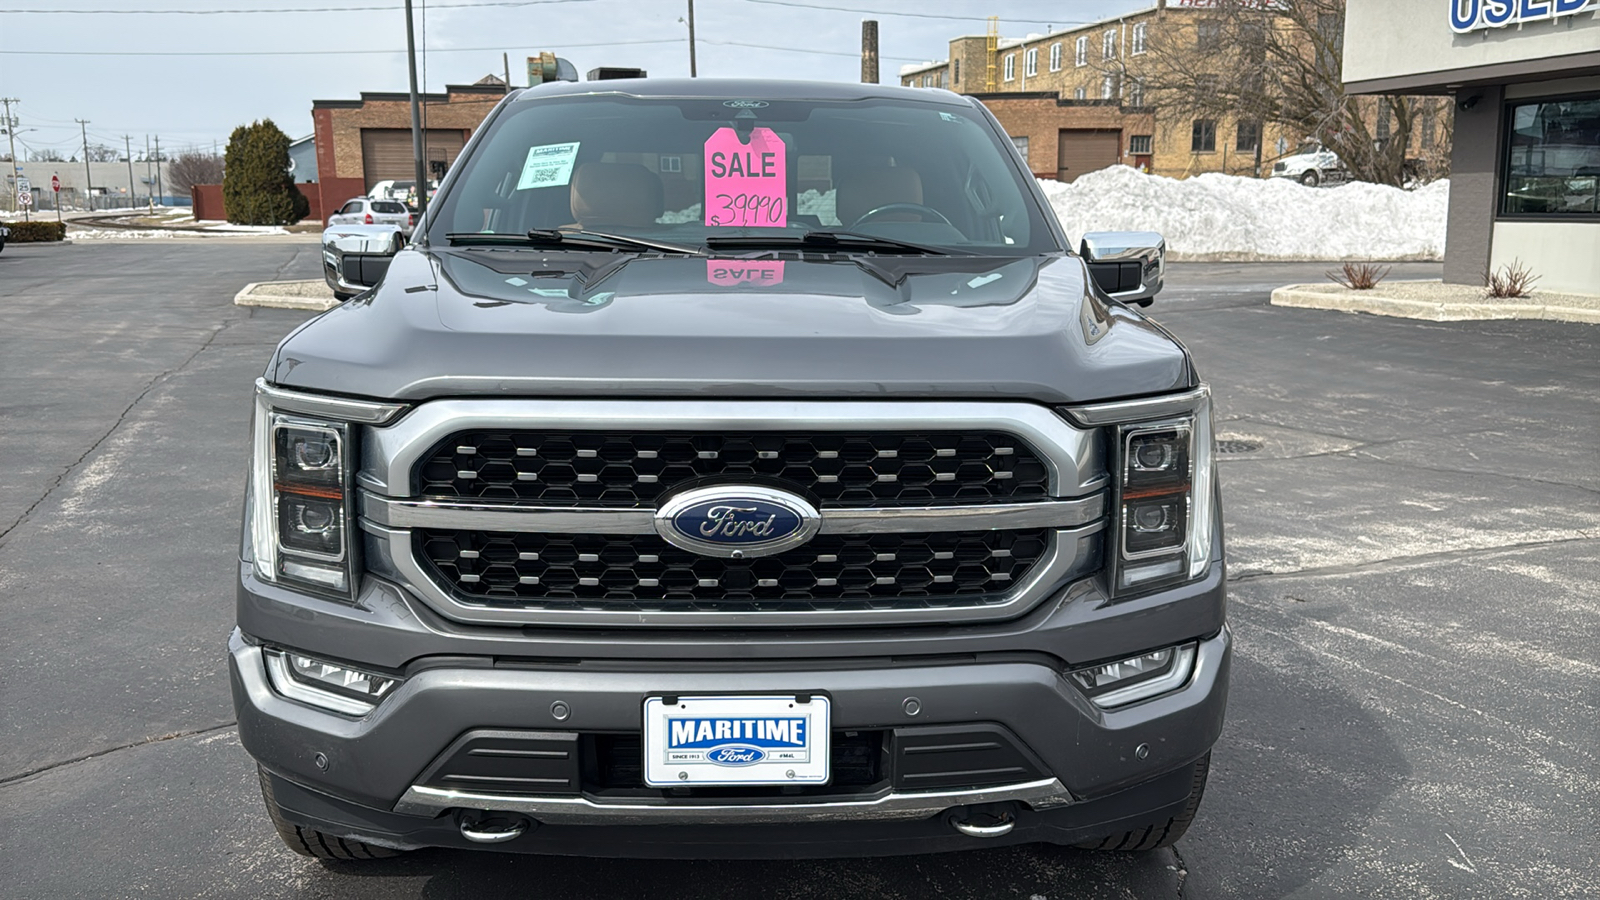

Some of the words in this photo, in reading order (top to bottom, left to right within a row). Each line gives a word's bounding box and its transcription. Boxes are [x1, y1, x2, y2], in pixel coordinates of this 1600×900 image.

[711, 152, 776, 178] SALE
[700, 505, 776, 537] Ford
[672, 720, 804, 747] MARITIME
[717, 749, 754, 762] Ford
